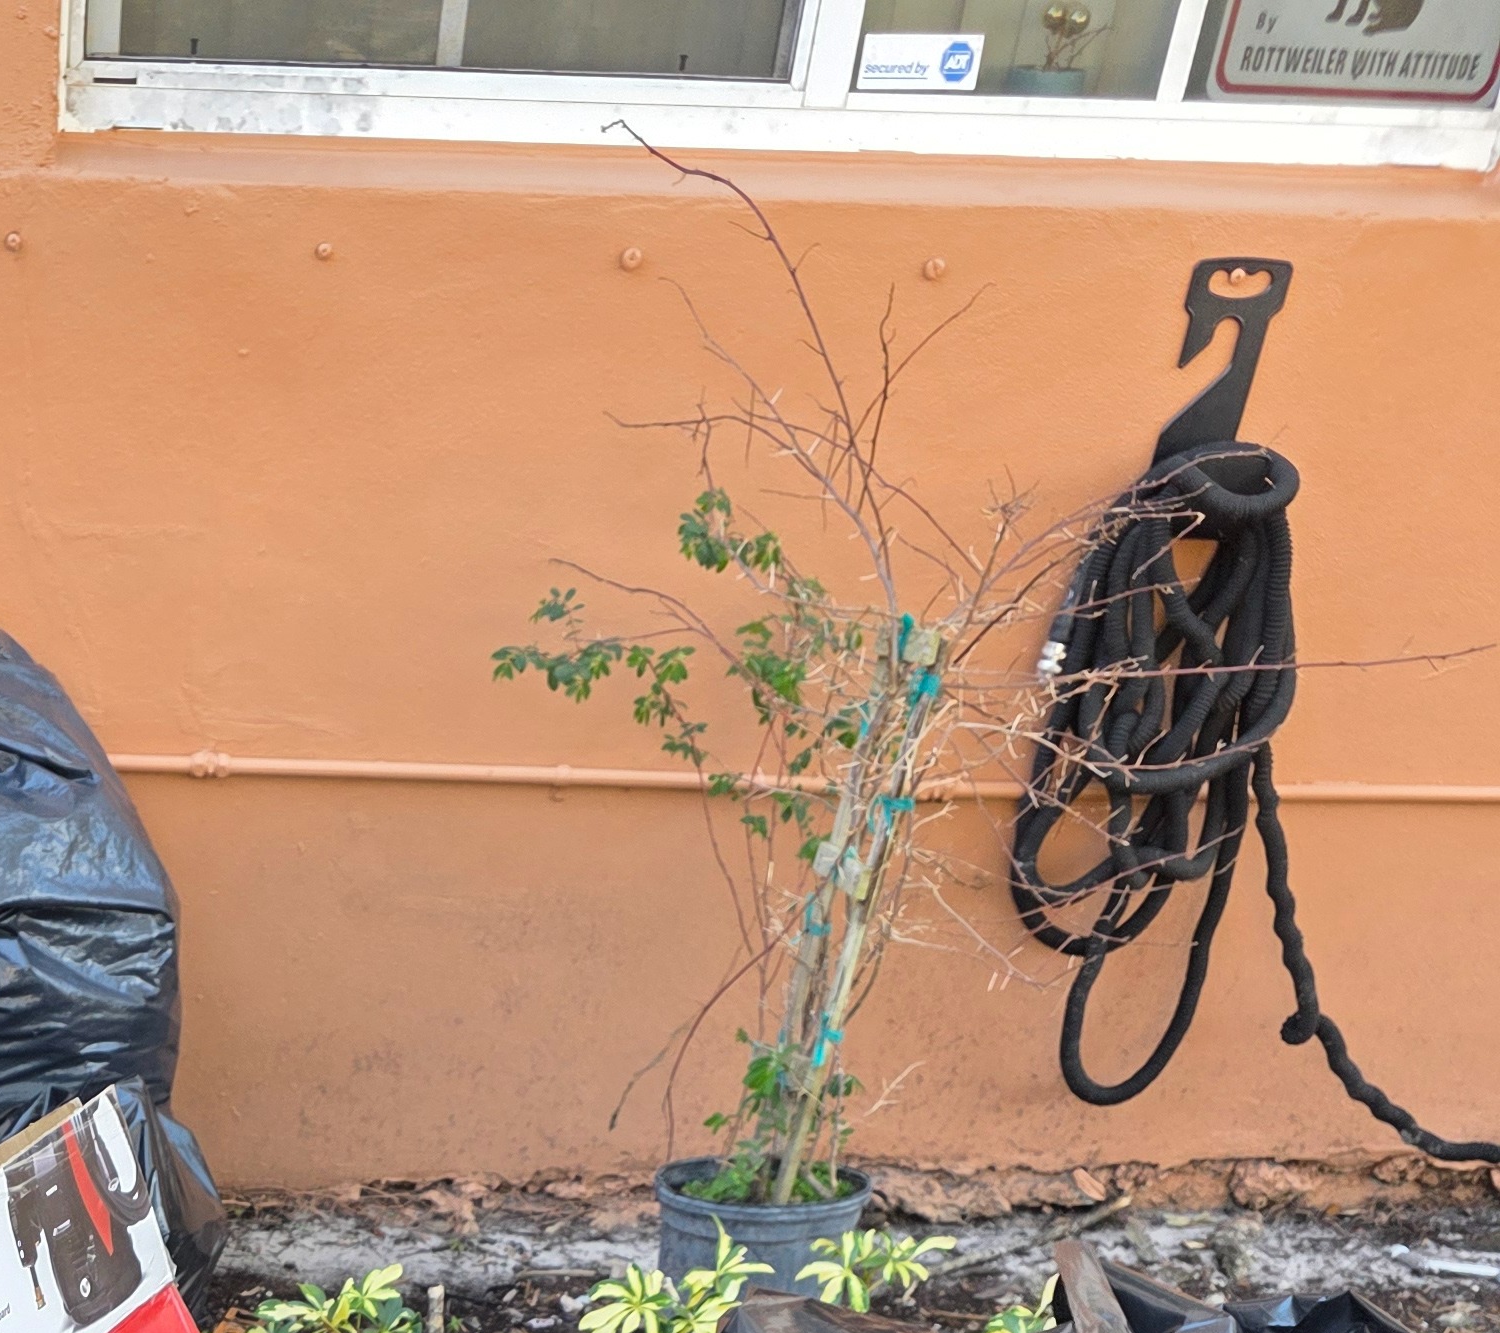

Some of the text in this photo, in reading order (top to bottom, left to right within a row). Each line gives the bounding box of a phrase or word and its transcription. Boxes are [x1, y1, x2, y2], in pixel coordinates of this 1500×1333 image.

[1256, 11, 1279, 34] By
[864, 61, 930, 75] secured by
[944, 54, 970, 70] ADT
[1240, 46, 1482, 80] ROTTWEILER WITH ATTITUDE
